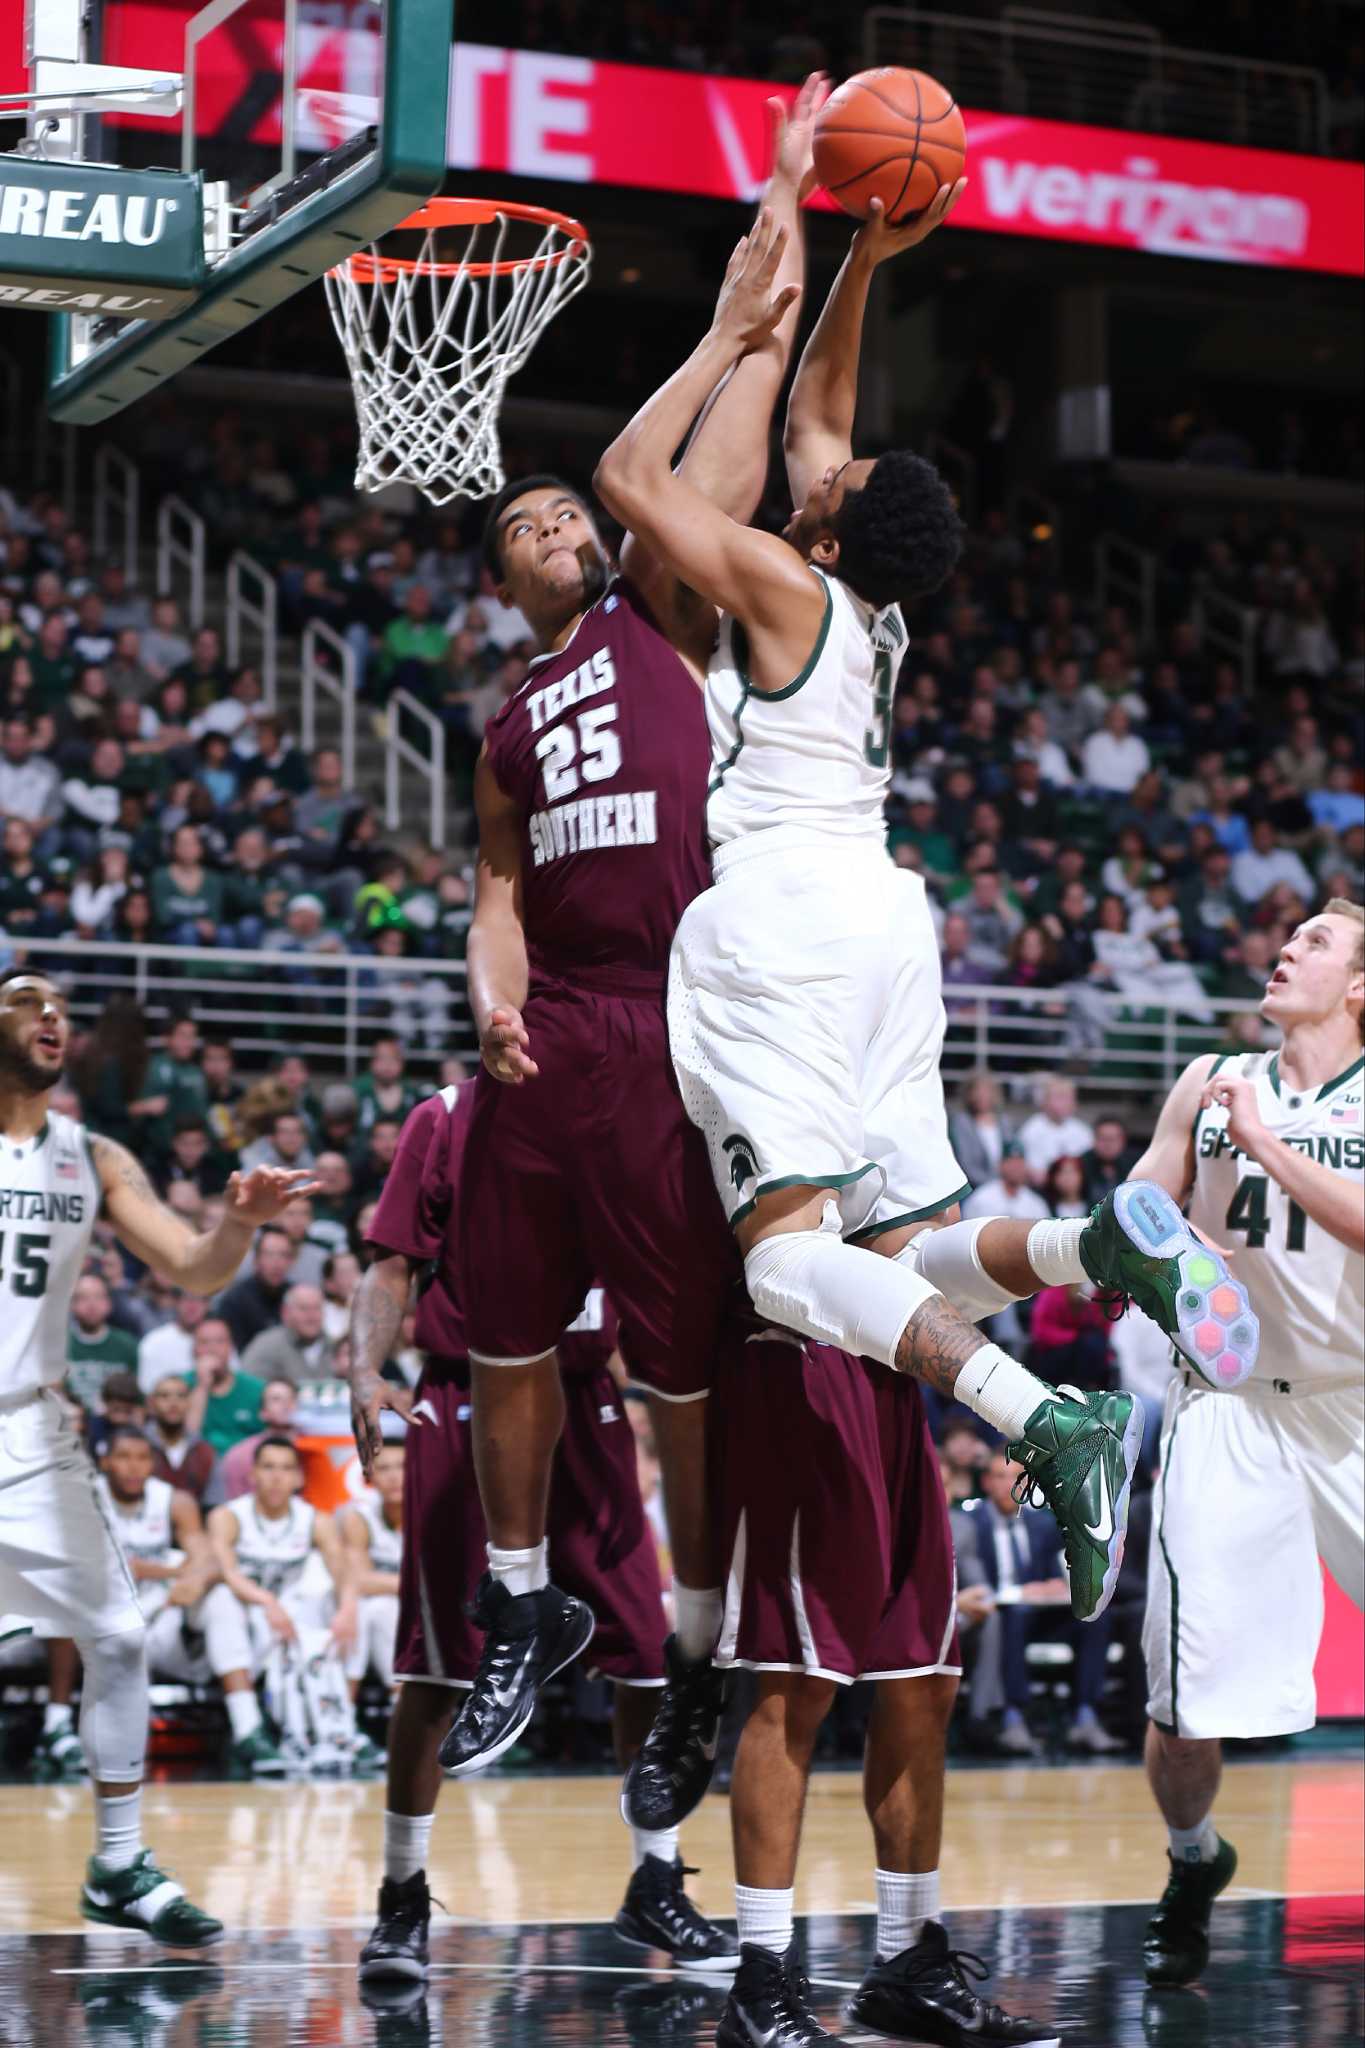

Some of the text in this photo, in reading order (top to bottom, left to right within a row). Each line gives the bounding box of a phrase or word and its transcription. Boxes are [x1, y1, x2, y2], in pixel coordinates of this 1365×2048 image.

[0, 184, 178, 246] REAU
[526, 646, 616, 732] TEXAS
[863, 651, 892, 768] 3
[535, 702, 622, 804] 25
[529, 791, 658, 867] SOUTHERN
[1226, 1174, 1306, 1252] 41
[0, 1231, 51, 1298] 5
